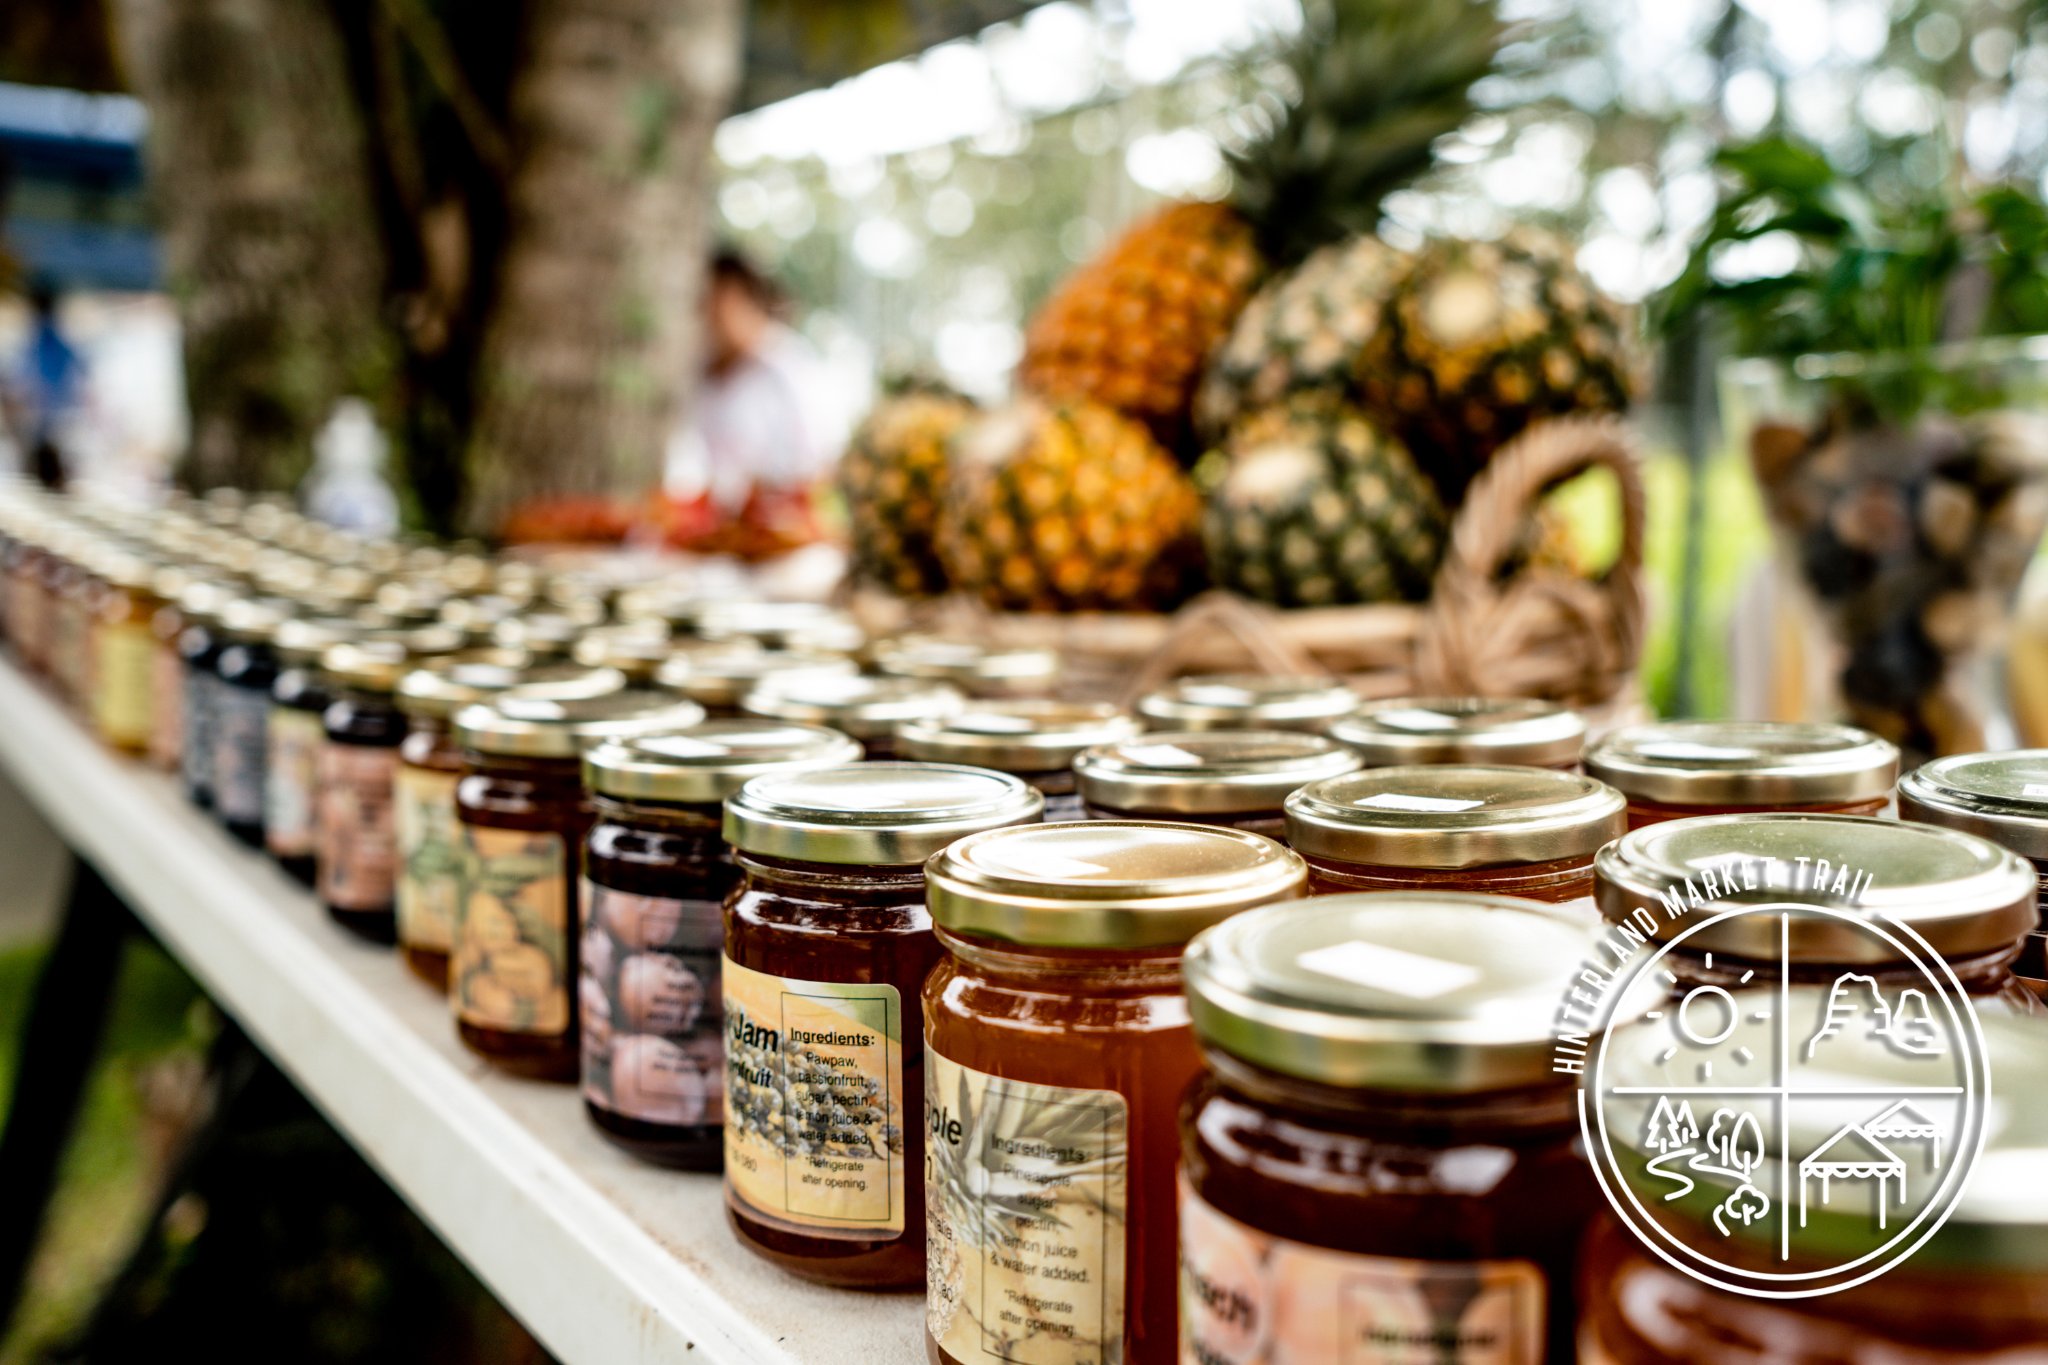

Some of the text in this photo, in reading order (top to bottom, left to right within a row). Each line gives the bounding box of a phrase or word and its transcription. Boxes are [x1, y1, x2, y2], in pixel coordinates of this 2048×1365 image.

[733, 1012, 779, 1052] Jam
[790, 1027, 876, 1047] Ingredients:
[806, 1051, 858, 1069] Pawpaw,
[798, 1072, 868, 1089] passionfruit,
[833, 1093, 872, 1107] pectin,
[832, 1111, 860, 1127] juice
[863, 1113, 873, 1126] &
[1043, 1241, 1078, 1259] juice
